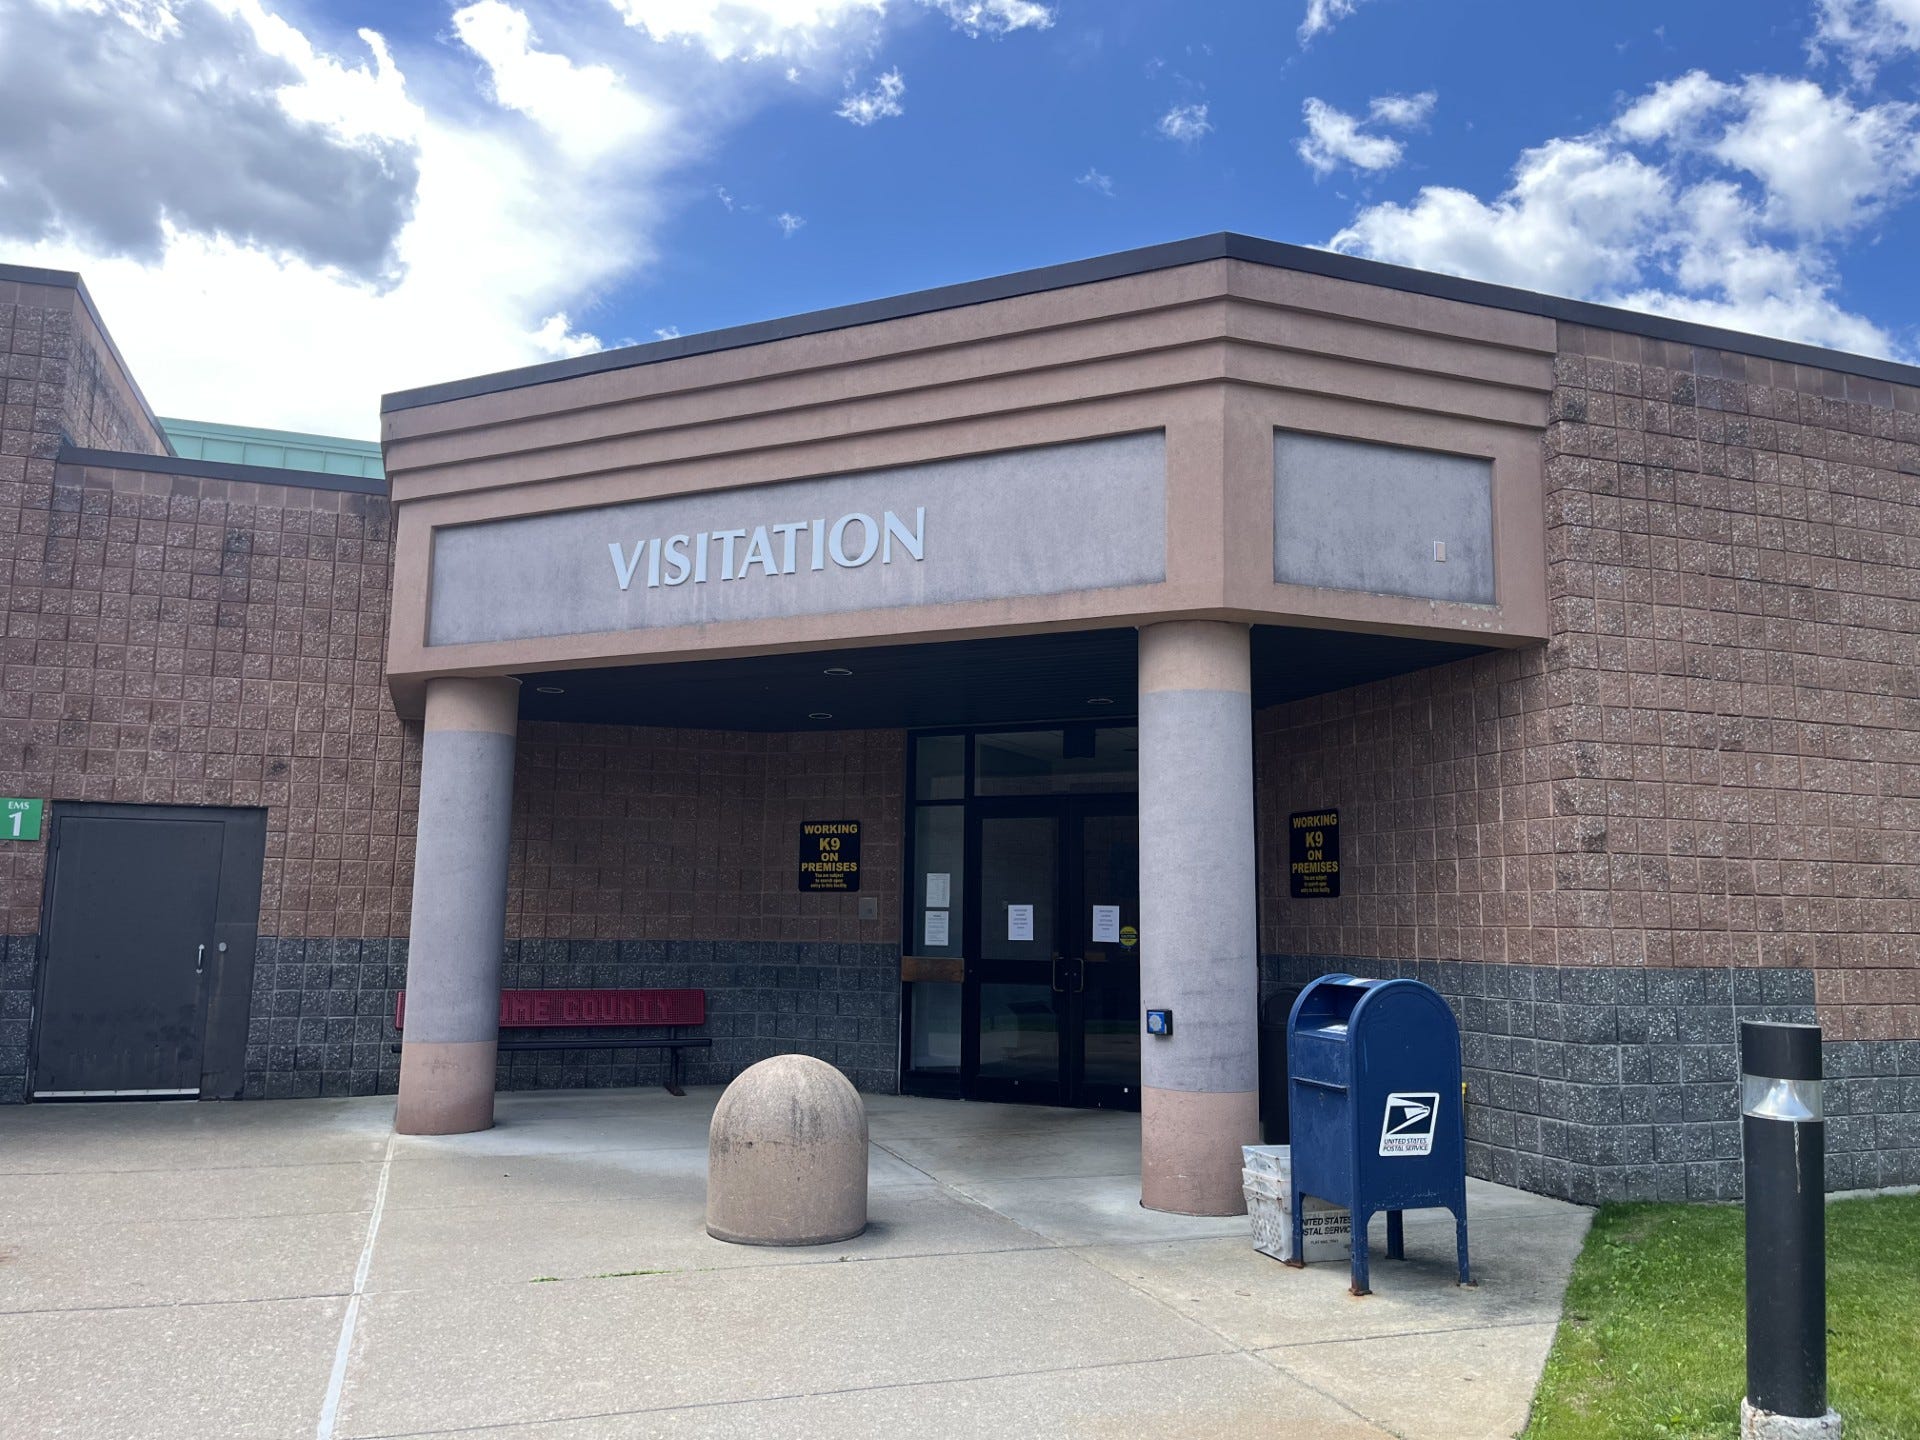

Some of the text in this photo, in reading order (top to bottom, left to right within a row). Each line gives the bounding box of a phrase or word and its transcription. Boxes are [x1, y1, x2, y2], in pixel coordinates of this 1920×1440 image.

[608, 506, 926, 591] VISITATION
[8, 801, 30, 810] EMS
[9, 811, 22, 837] 1
[1292, 813, 1338, 829] WORKING
[803, 824, 858, 835] WORKING
[819, 837, 841, 851] K9
[1305, 831, 1324, 848] K9
[820, 852, 839, 862] ON
[1307, 849, 1323, 861] ON
[801, 862, 858, 872] PREMISES
[1292, 861, 1339, 874] PREMISES
[563, 996, 673, 1021] COUNTY
[1406, 1137, 1428, 1145] STATES
[1302, 1217, 1324, 1226] NITED
[1302, 1225, 1351, 1236] STAL SERVIC
